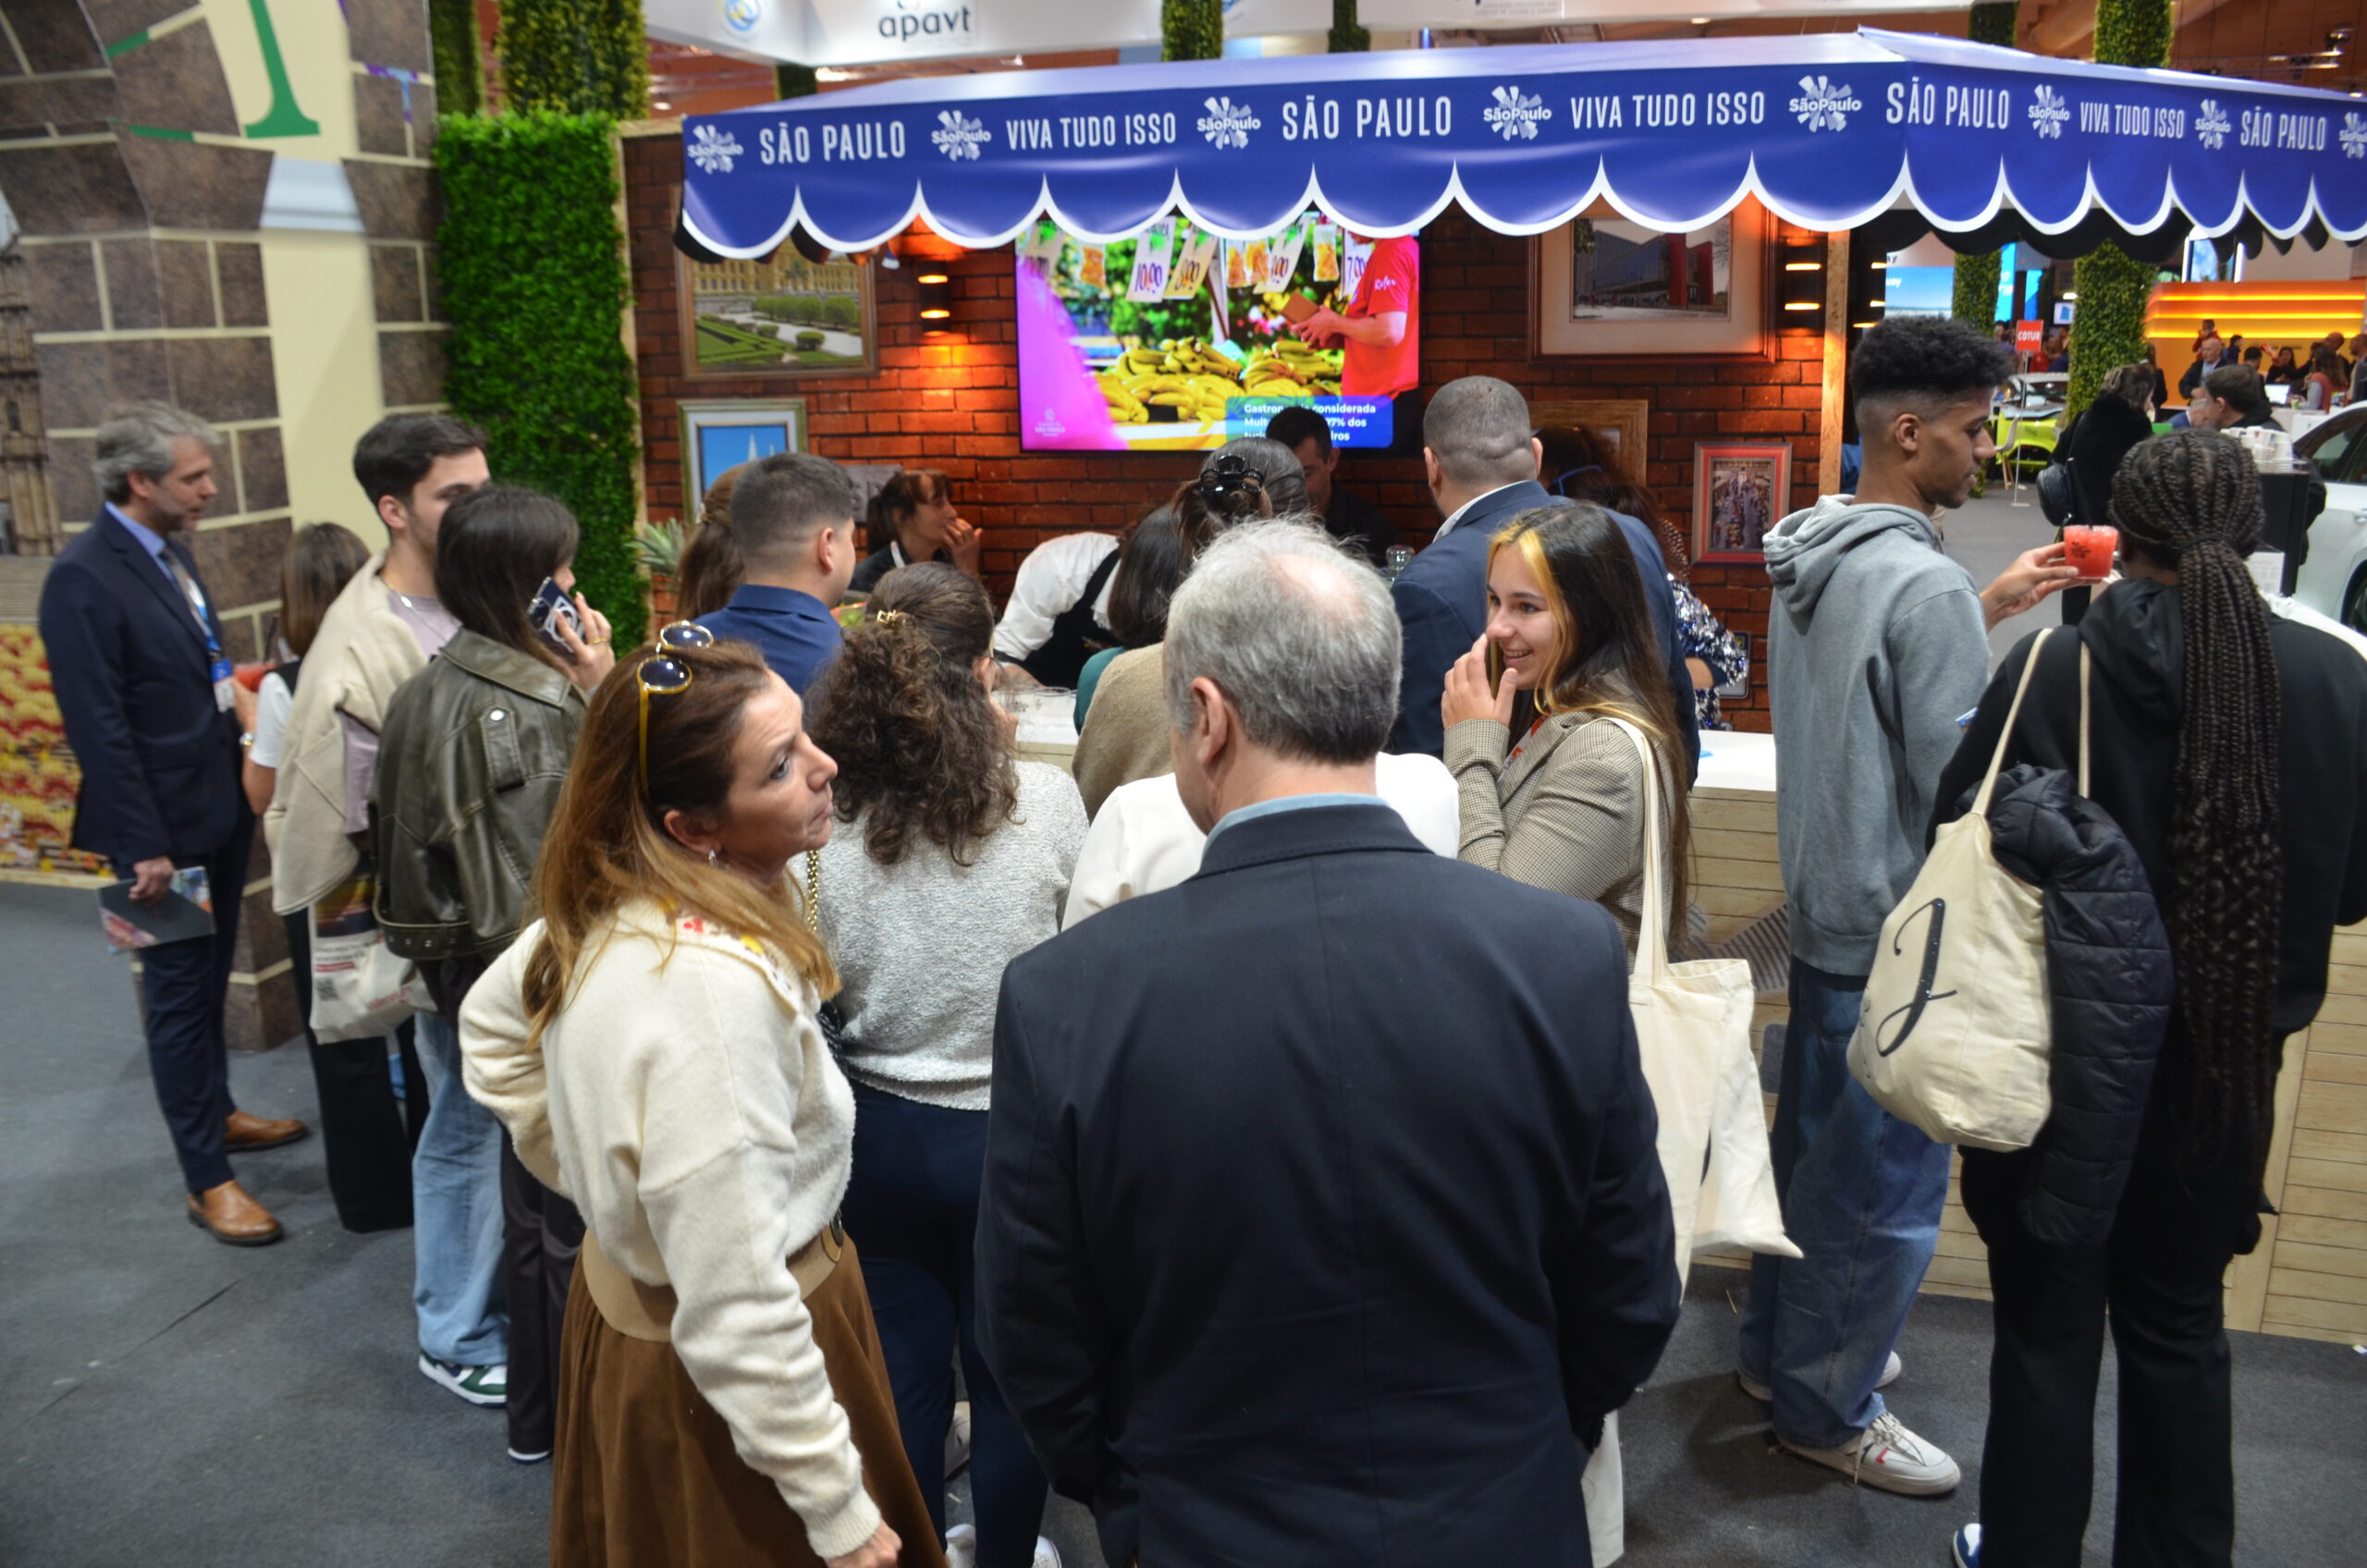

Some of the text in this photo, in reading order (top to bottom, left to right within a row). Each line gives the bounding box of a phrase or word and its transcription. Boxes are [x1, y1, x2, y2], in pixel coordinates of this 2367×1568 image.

[878, 7, 970, 42] apavt
[1282, 94, 1452, 141] SÃO PAULO
[1483, 105, 1551, 123] SãoPaulo
[1570, 91, 1765, 129] VIVA TUDO ISSO
[1788, 95, 1862, 113] SãoPaulo
[1885, 76, 2010, 129] SÃO PAULO
[2028, 104, 2070, 122] SãoPaulo
[931, 128, 992, 145] SãoPaulo
[1005, 112, 1176, 151] VIVA TUDO ISSO
[1196, 116, 1261, 133] SãoPaulo
[2079, 101, 2185, 140] VIVA TUDO ISSO
[2239, 105, 2326, 152] SÃO PAULO
[759, 120, 906, 165] SÃO PAULO
[1312, 403, 1376, 414] considerada
[1347, 416, 1367, 427] dos
